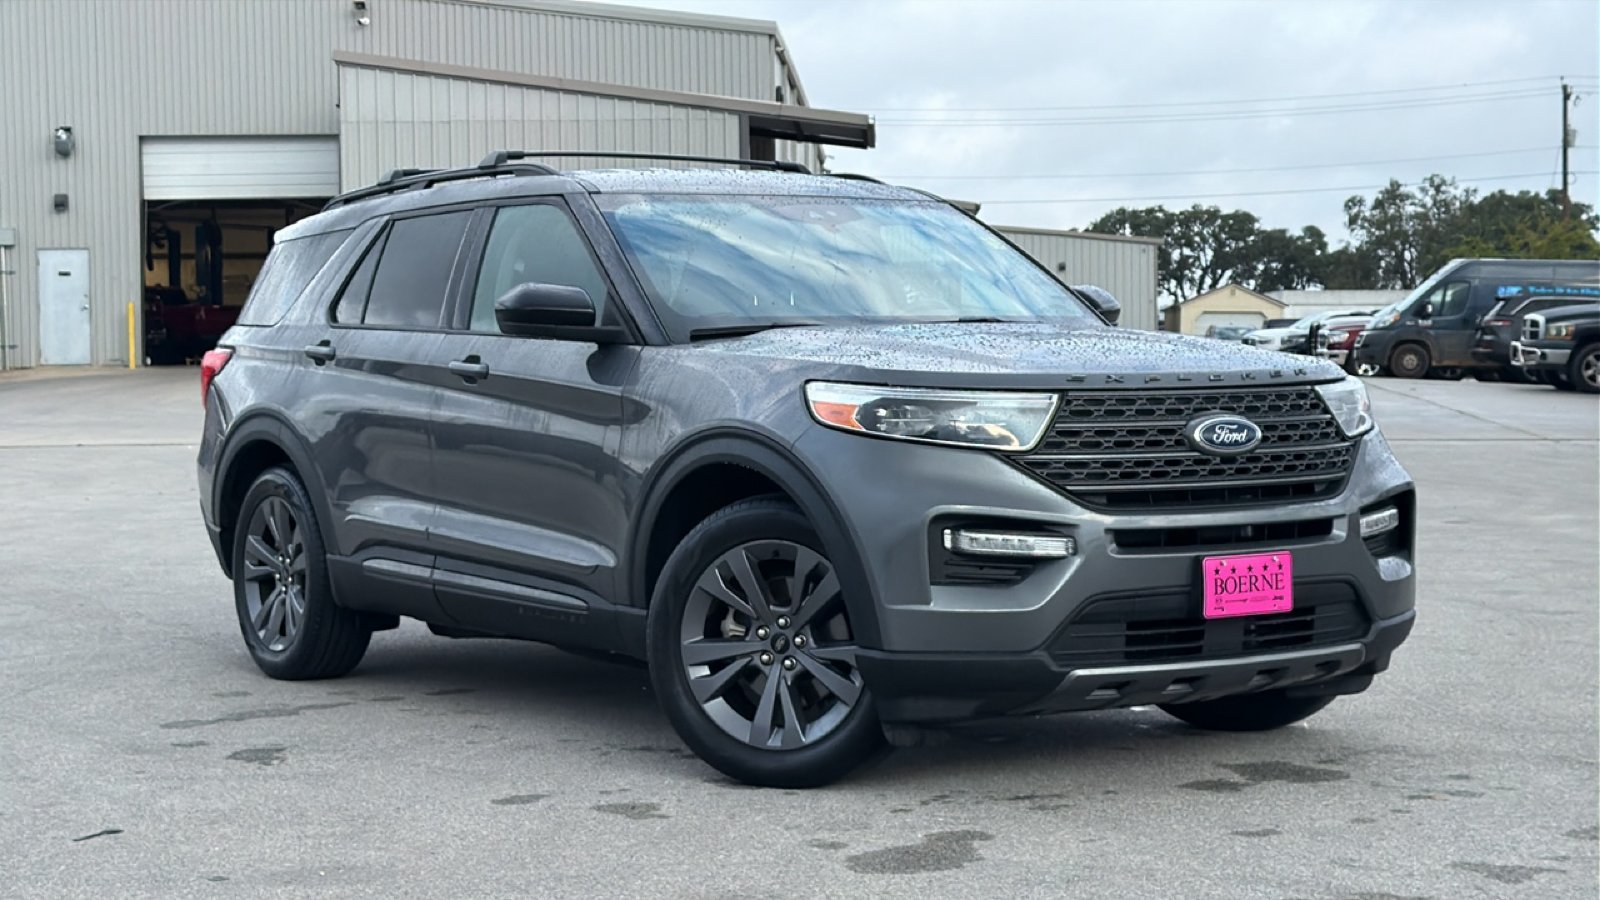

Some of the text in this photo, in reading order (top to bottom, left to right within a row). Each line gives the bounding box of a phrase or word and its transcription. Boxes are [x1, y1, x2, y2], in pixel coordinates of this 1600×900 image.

[1065, 369, 1307, 385] EXPLORER
[1213, 424, 1247, 444] Ford
[1214, 572, 1285, 596] BOERNE
